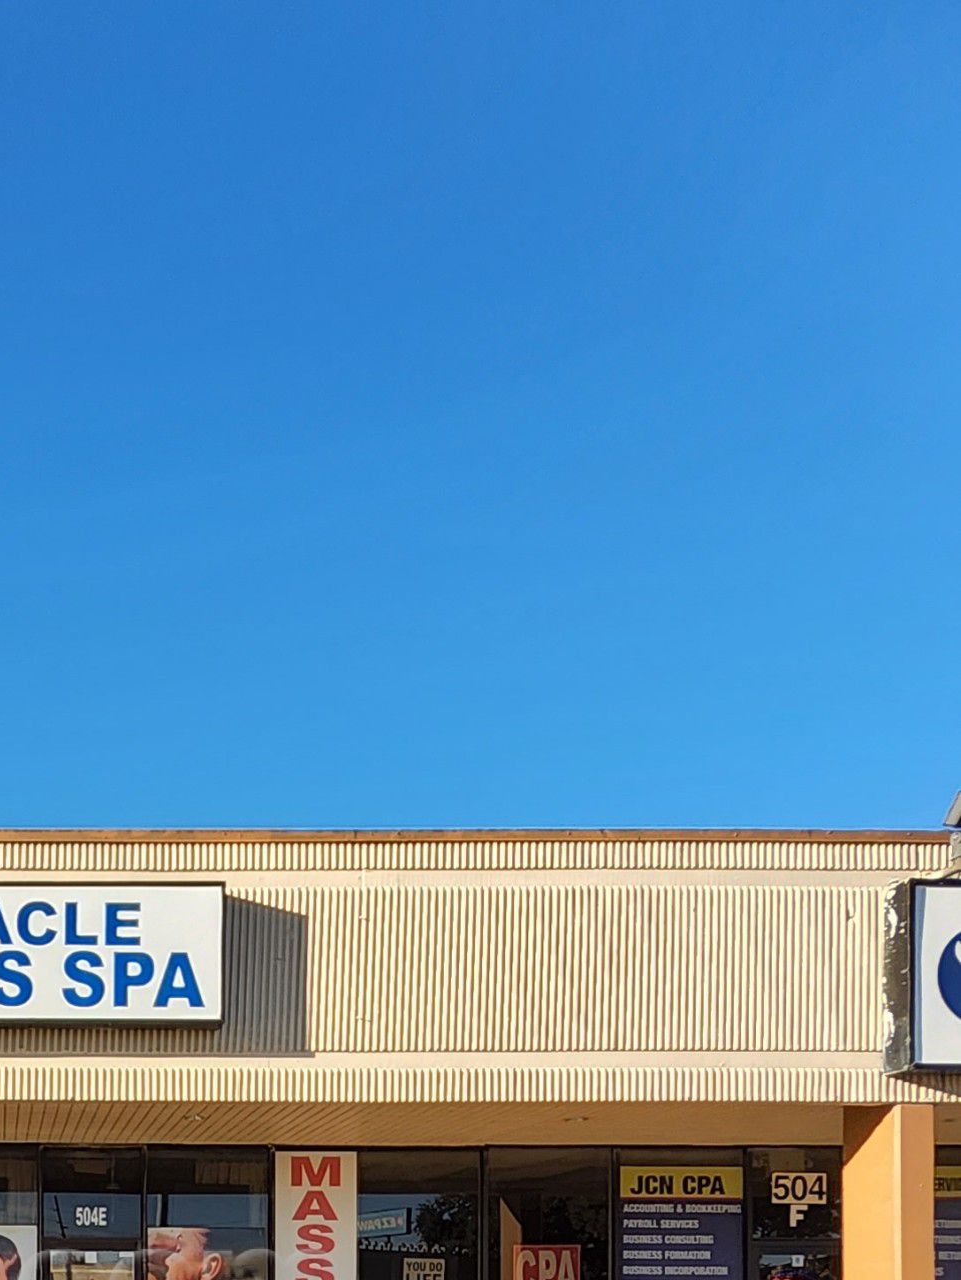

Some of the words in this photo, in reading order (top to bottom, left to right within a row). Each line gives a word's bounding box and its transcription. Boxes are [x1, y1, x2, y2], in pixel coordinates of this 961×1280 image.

[61, 951, 205, 1008] SPA
[630, 1175, 674, 1195] JCN
[682, 1175, 726, 1195] CPA
[773, 1175, 826, 1201] 504
[623, 1204, 674, 1213] ACCOUNTING
[75, 1206, 108, 1227] 504E
[789, 1204, 809, 1228] F
[623, 1219, 658, 1228] PAYROLL
[660, 1219, 699, 1228] SERVICES
[623, 1235, 663, 1244] BUSINESS
[665, 1235, 714, 1244] CONSULTING
[623, 1250, 663, 1259] BUSINESS
[665, 1251, 711, 1259] FORMATION
[406, 1262, 425, 1272] YOU
[429, 1261, 443, 1272] DO
[623, 1266, 663, 1275] BUSINESS
[665, 1266, 729, 1275] INCORPORATION
